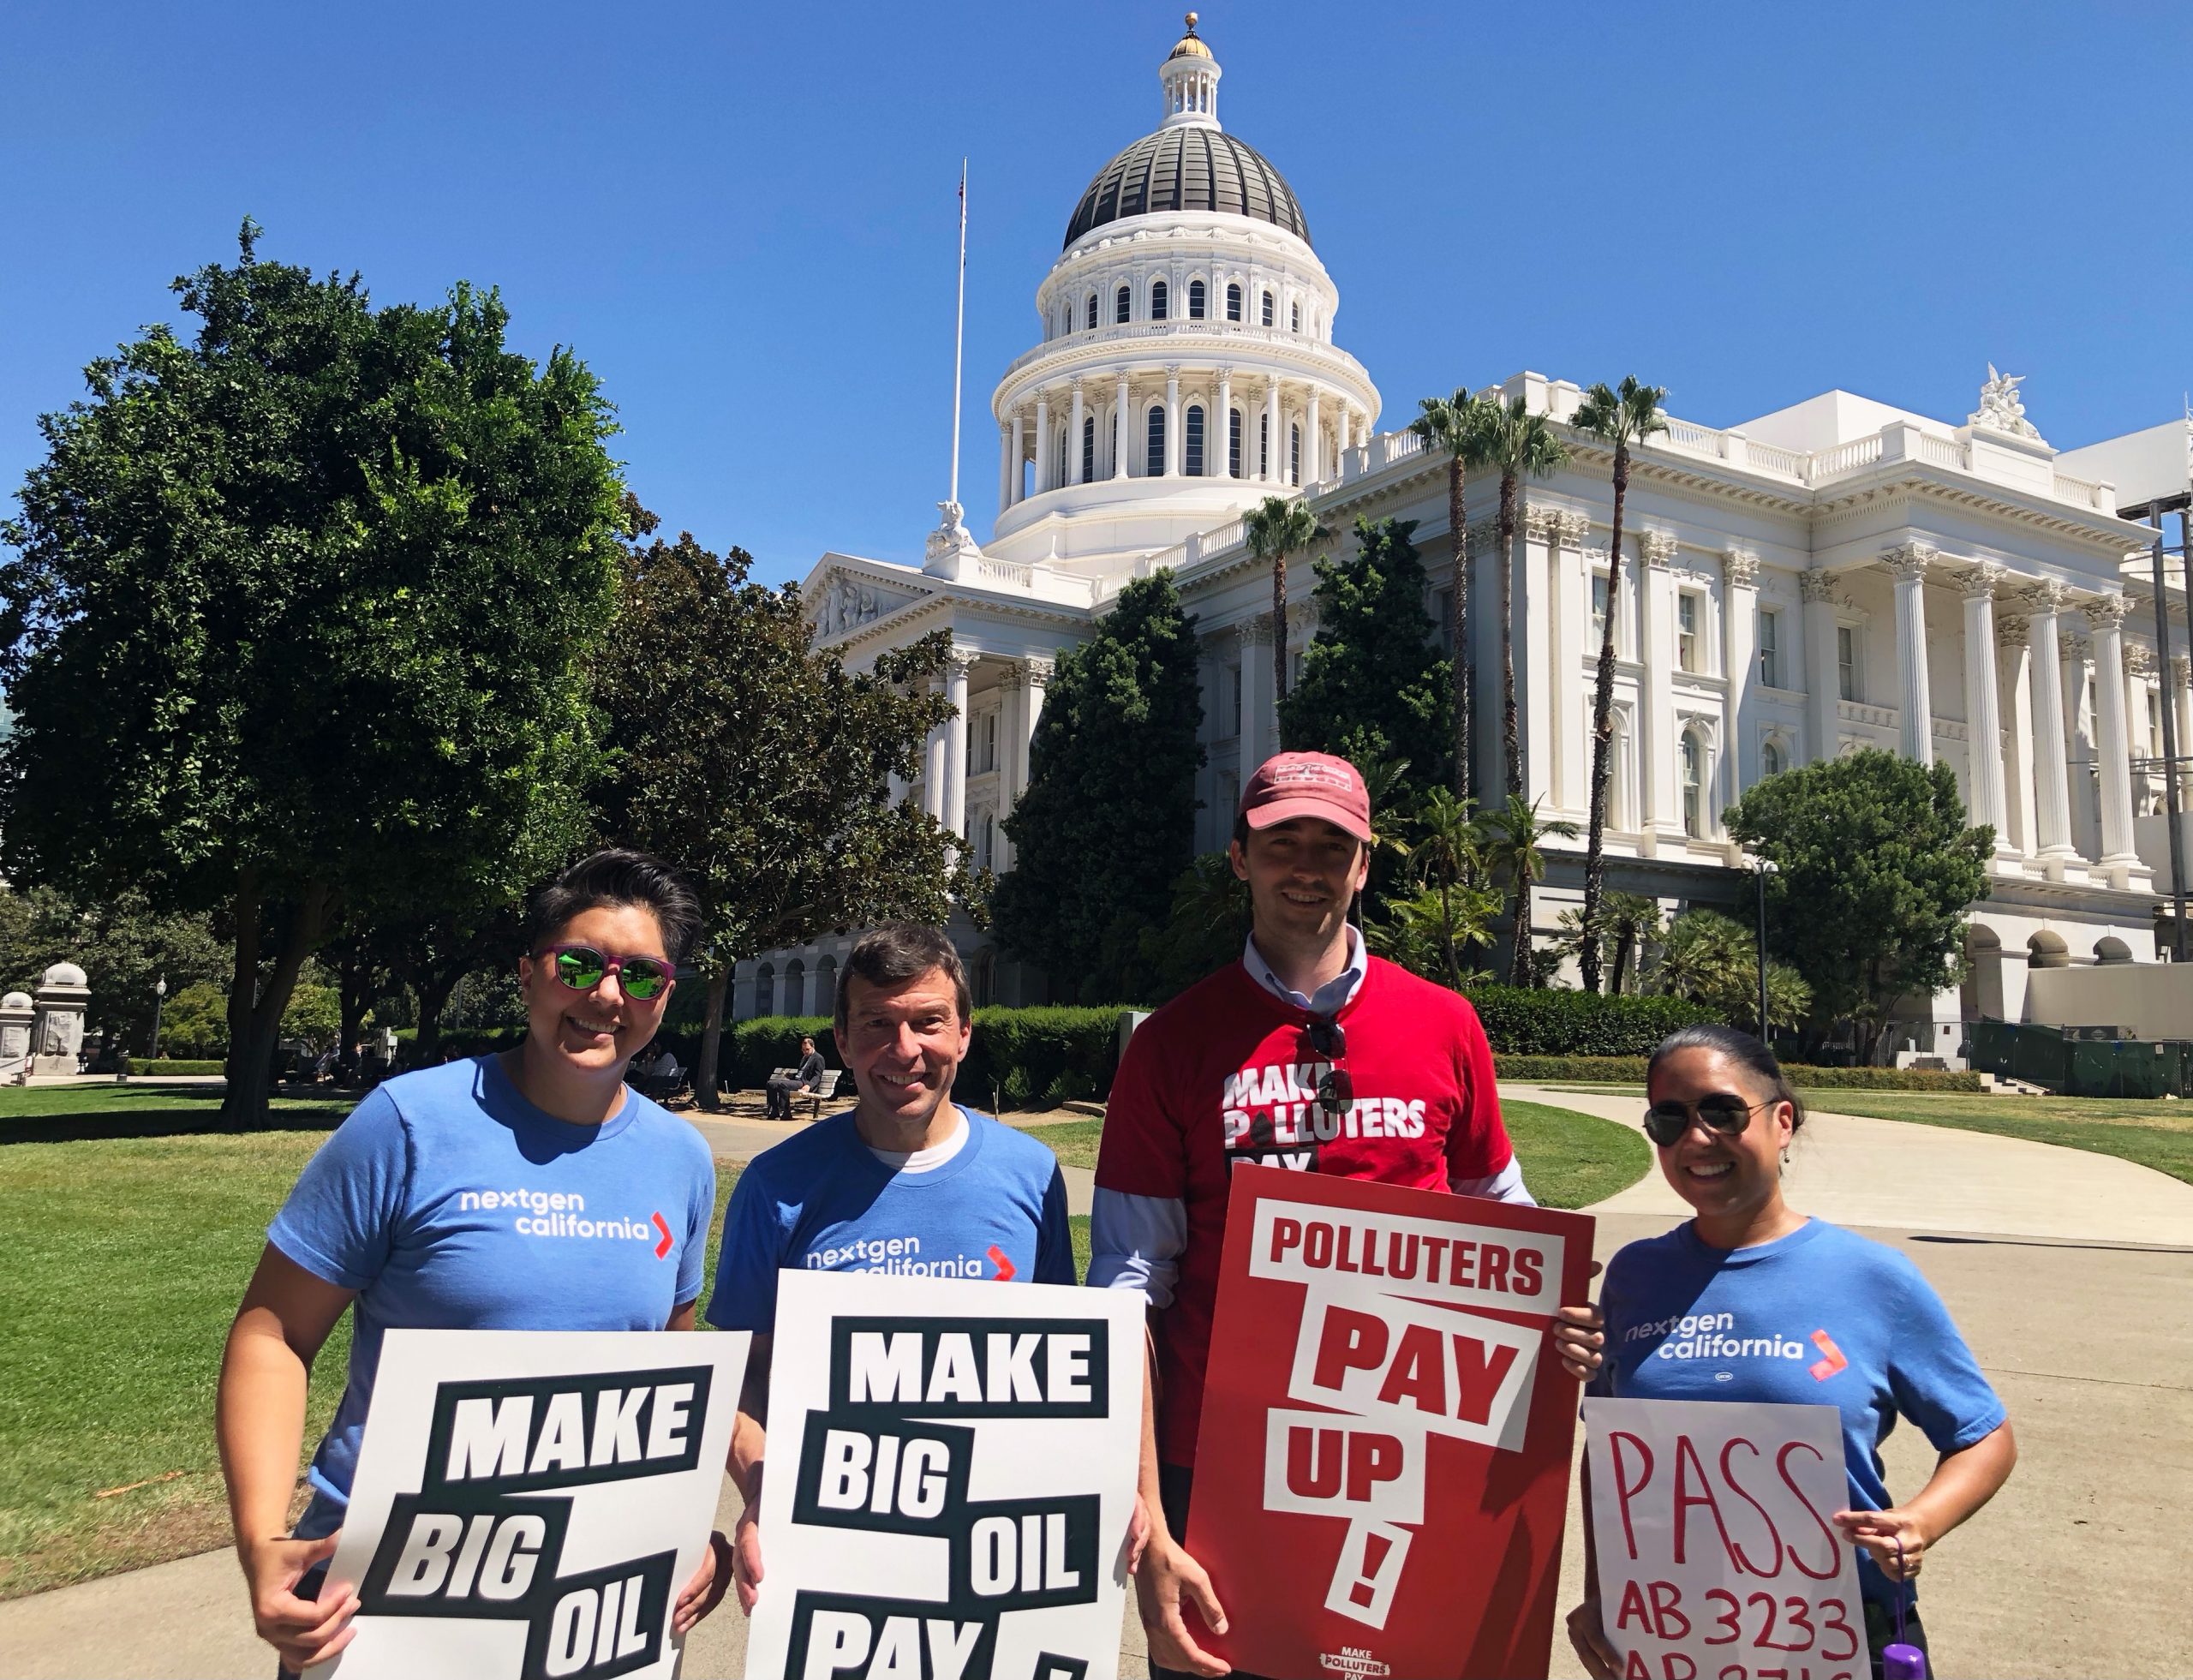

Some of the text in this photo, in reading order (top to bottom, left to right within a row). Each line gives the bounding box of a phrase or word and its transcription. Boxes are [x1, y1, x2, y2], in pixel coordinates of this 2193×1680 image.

[461, 1188, 584, 1215] nextgen
[516, 1212, 649, 1240] california
[807, 1236, 920, 1269] nextgen
[1270, 1217, 1544, 1296] POLLUTERS
[1625, 1312, 1733, 1342] nextgen
[1658, 1334, 1803, 1360] california
[849, 1331, 1091, 1402] MAKE
[1312, 1305, 1519, 1426] PAY
[445, 1383, 695, 1482] MAKE
[1287, 1426, 1403, 1502] UP
[817, 1429, 950, 1519] BIG
[1609, 1431, 1841, 1580] PASS
[385, 1514, 546, 1600] BIG
[971, 1513, 1079, 1596] OIL
[545, 1575, 648, 1677] OIL
[804, 1610, 983, 1680] PAY
[1341, 1646, 1372, 1659] MAKE
[1616, 1580, 1859, 1661] AB 3233
[1324, 1655, 1386, 1674] POLLUTERS
[1344, 1671, 1365, 1680] PAY
